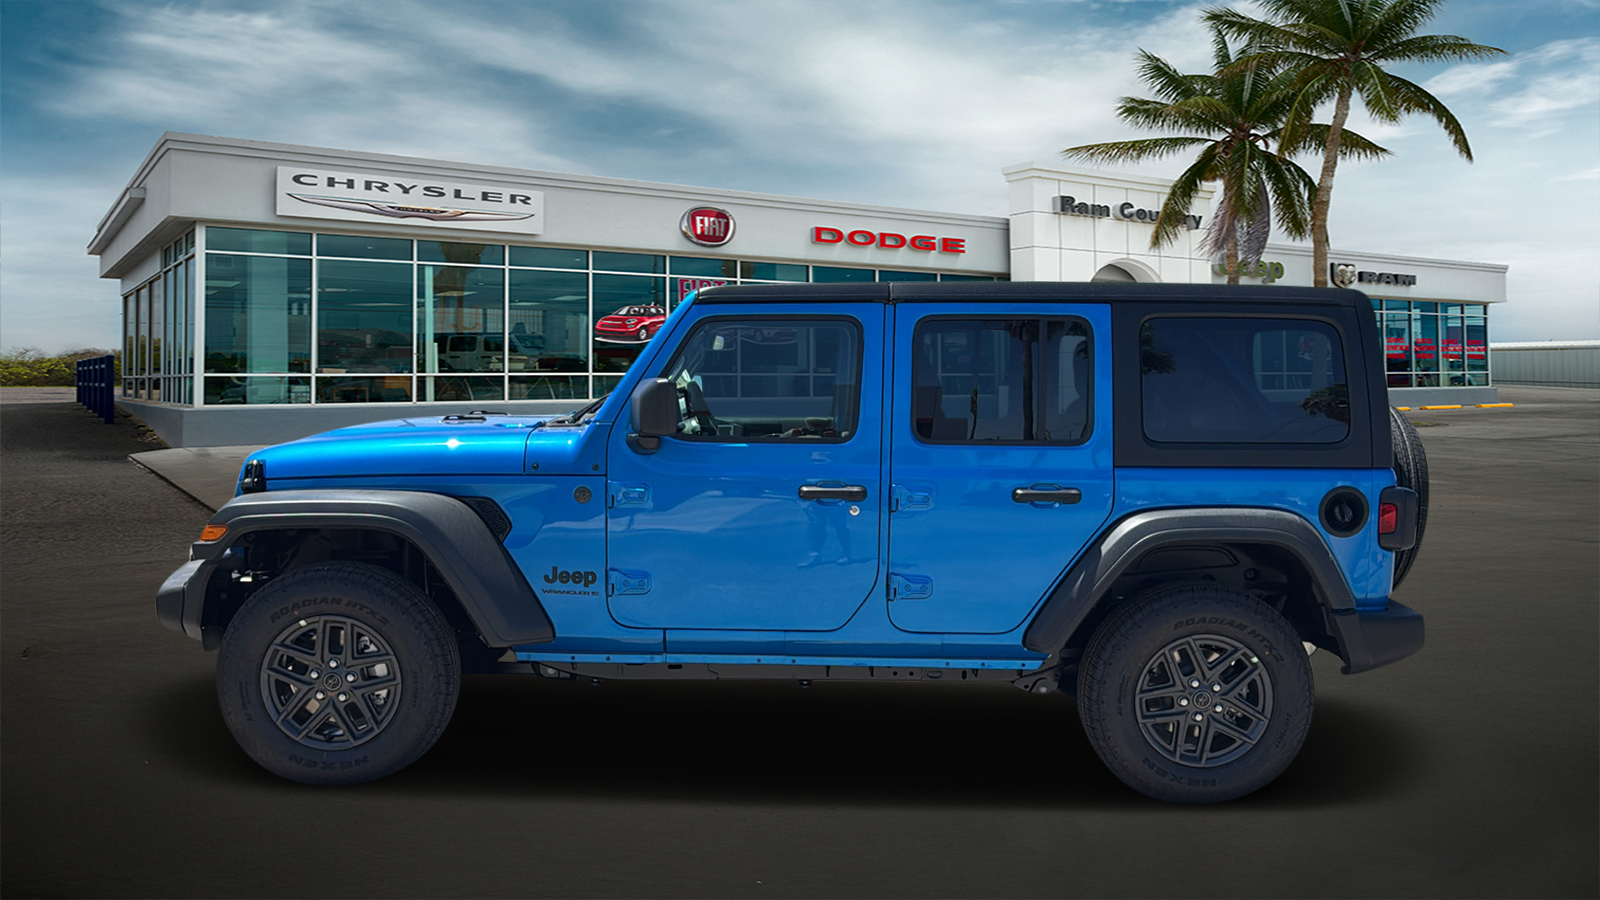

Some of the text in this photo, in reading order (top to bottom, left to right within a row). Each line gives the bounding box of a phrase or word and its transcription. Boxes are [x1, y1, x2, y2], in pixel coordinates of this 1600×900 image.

[292, 173, 533, 207] CHRYSLER
[1053, 195, 1203, 230] Ram Coury
[695, 215, 728, 237] FIAT
[812, 226, 966, 254] DODGE
[1358, 270, 1416, 286] RAM
[543, 566, 597, 588] Jeep
[542, 588, 590, 596] WRANGLER
[270, 597, 343, 623] ROADIAN
[1174, 616, 1248, 631] ROADIAN
[1141, 756, 1217, 787] NEXEN
